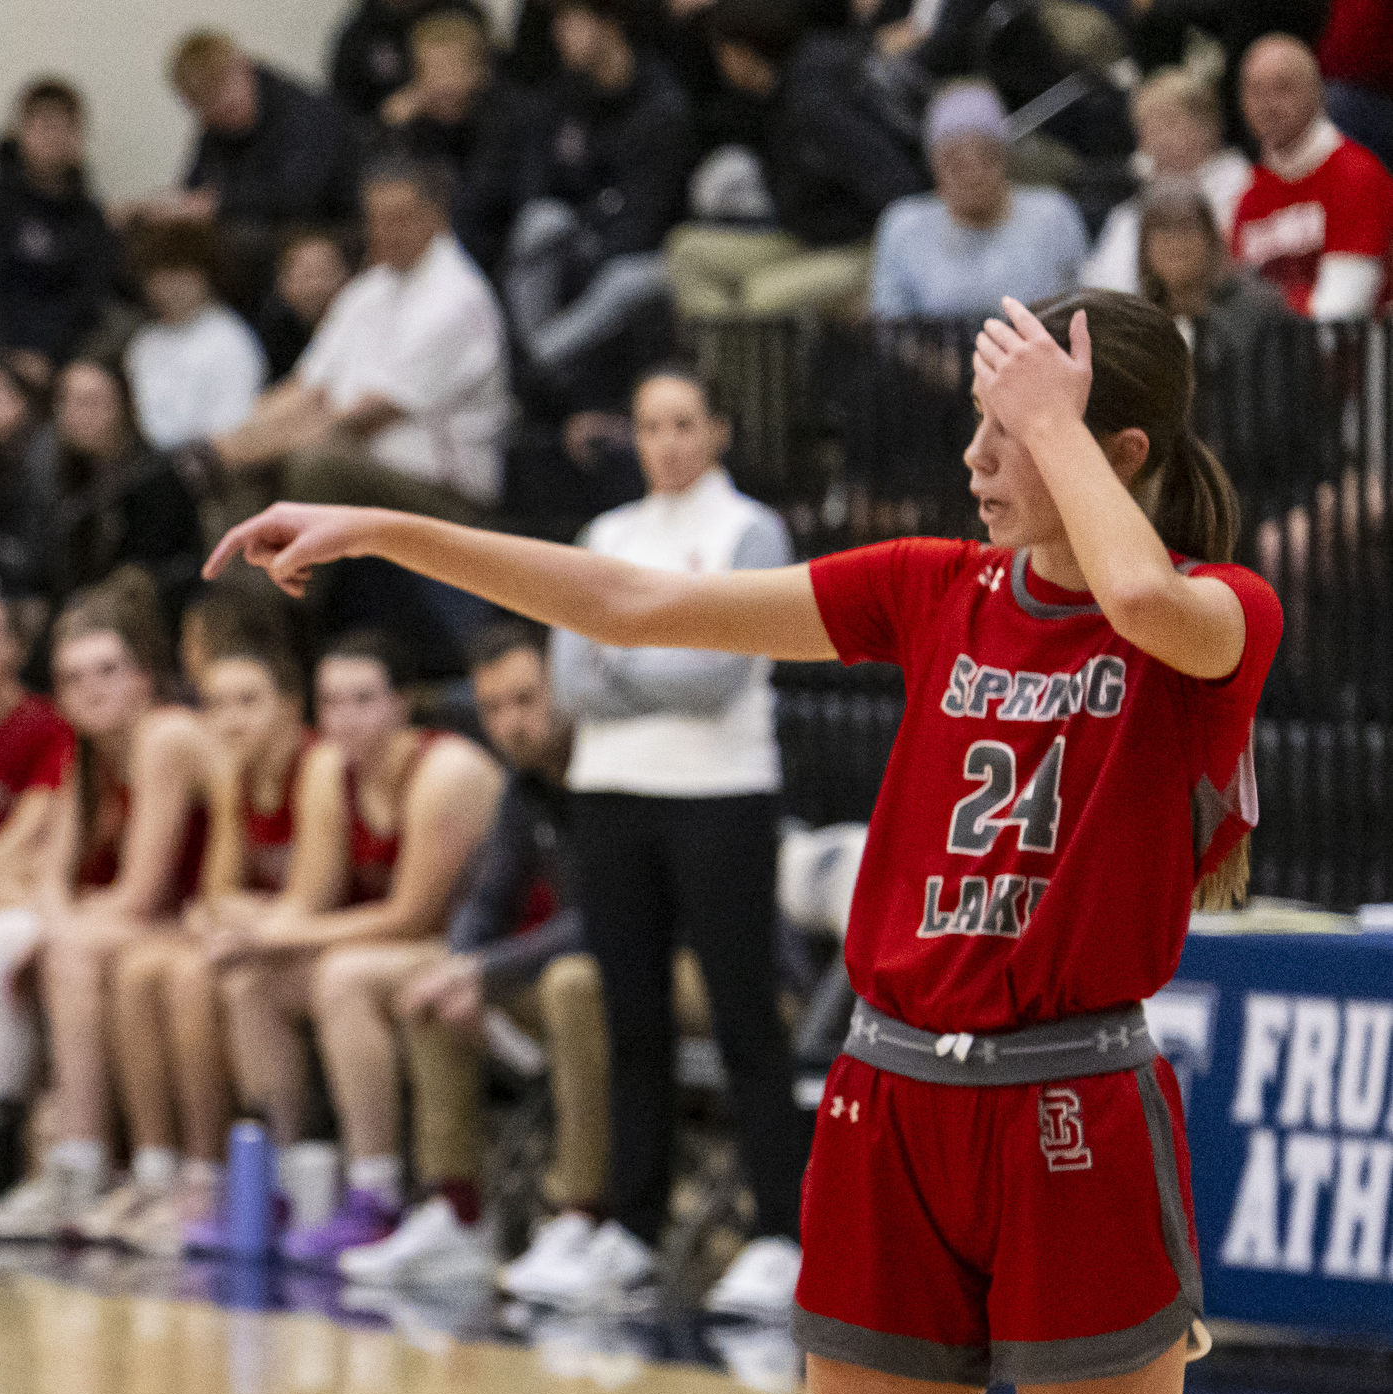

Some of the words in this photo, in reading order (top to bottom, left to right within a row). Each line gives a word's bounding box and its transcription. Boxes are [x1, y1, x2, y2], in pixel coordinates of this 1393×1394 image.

[946, 734, 1066, 857] 24
[1230, 992, 1393, 1134] FRU
[1220, 1128, 1393, 1283] ATH
